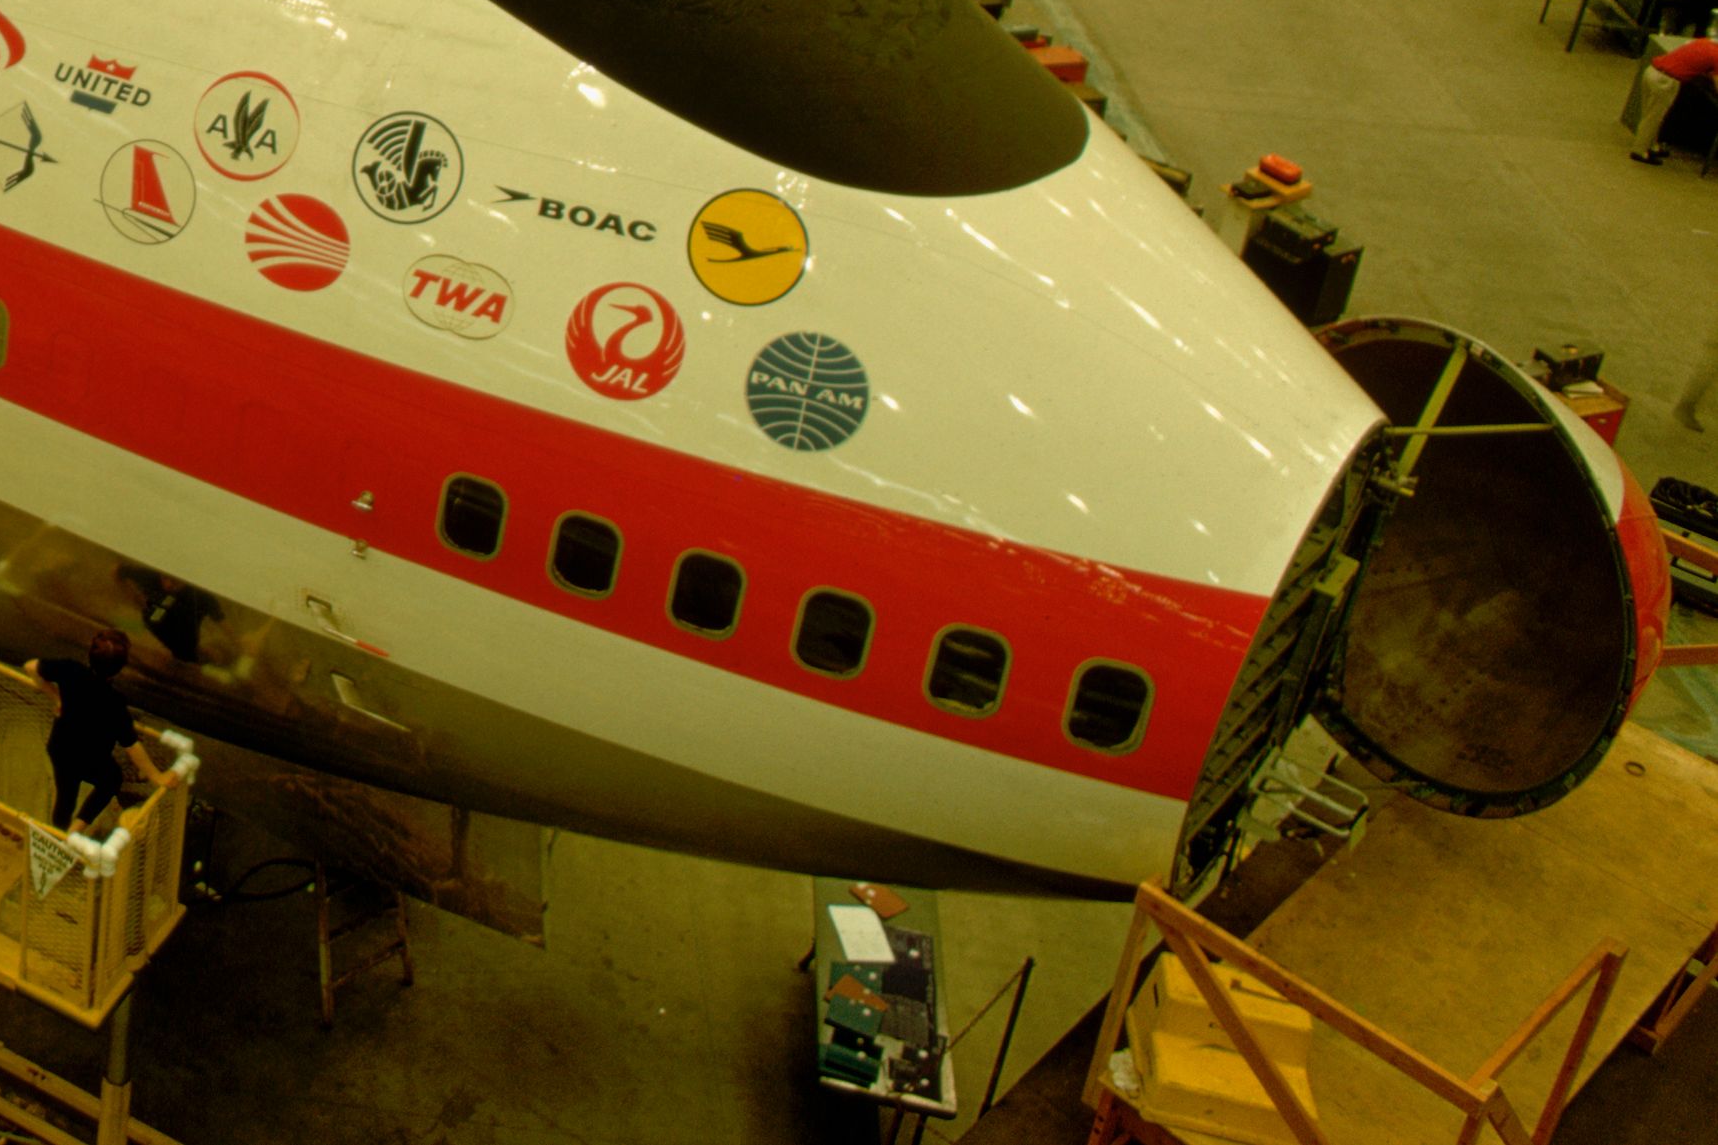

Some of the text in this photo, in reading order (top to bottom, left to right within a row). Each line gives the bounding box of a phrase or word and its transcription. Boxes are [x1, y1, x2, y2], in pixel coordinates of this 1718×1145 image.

[54, 62, 152, 107] UNITED
[536, 195, 658, 243] BOAC
[409, 269, 508, 325] TWA
[591, 364, 649, 394] JAL
[750, 370, 864, 410] PAN AM
[32, 831, 75, 865] CAUTION
